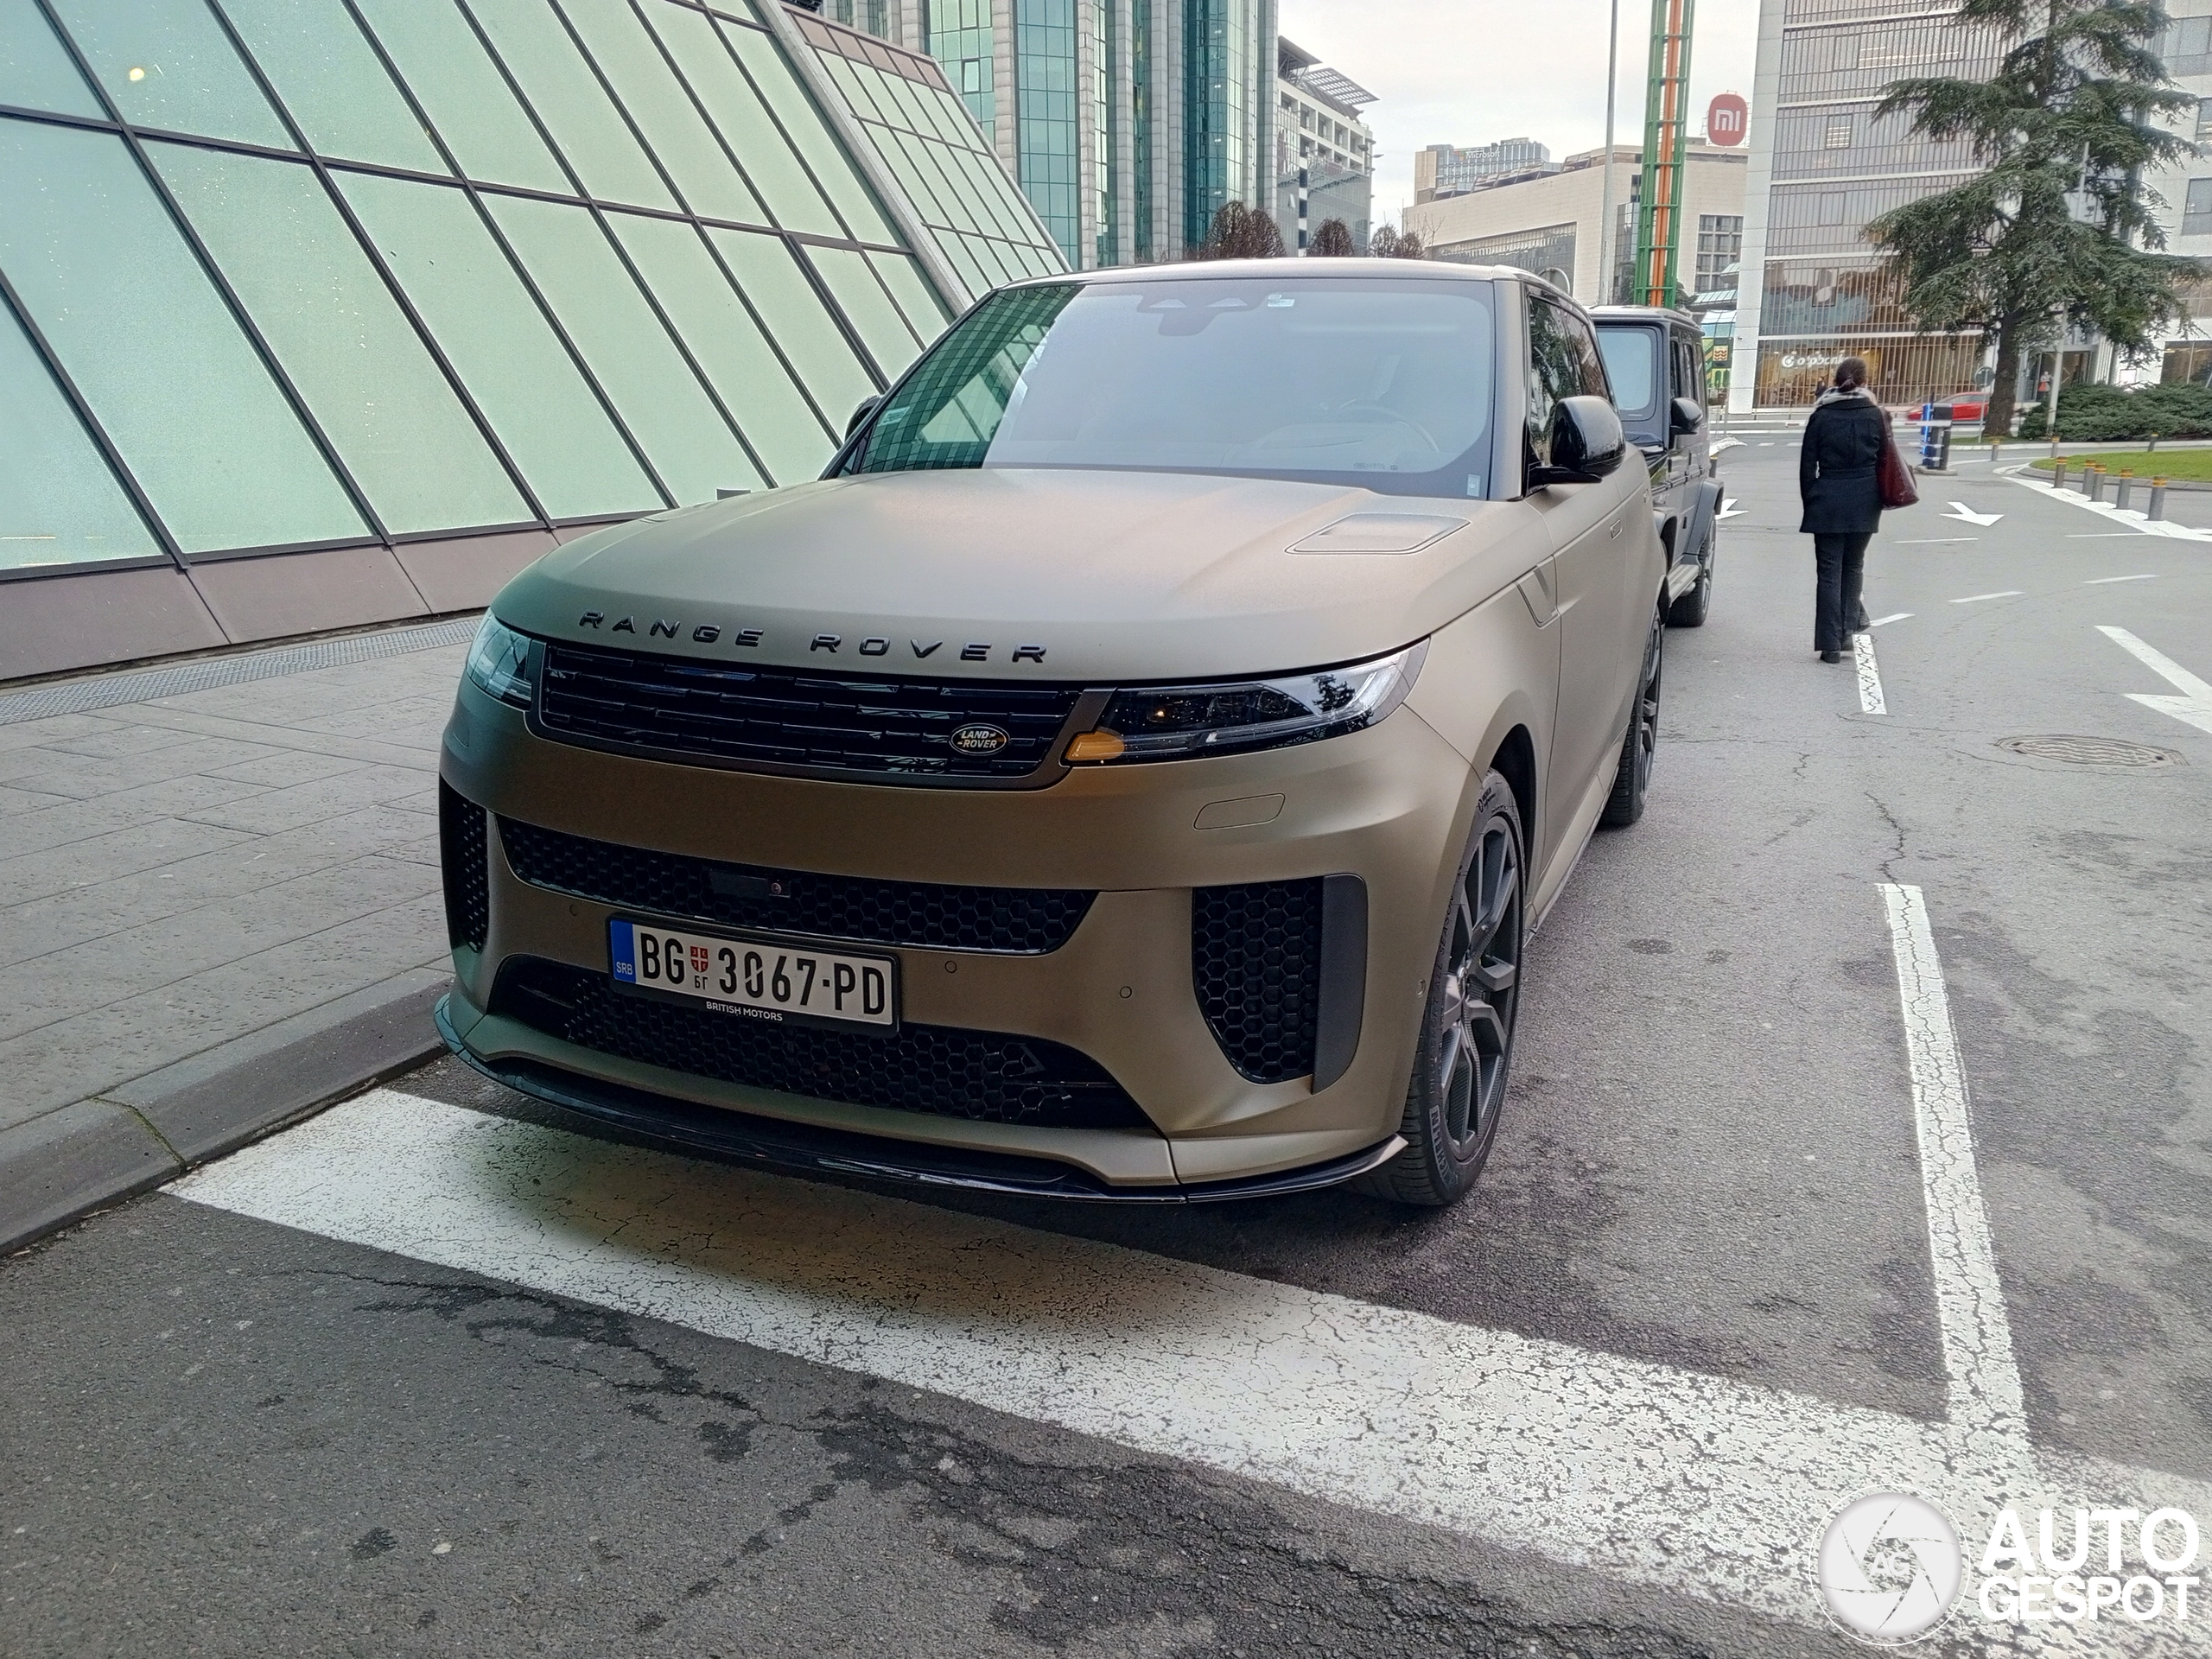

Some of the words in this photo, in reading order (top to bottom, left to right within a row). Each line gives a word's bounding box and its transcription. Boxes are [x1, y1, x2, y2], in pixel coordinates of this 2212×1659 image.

[1465, 149, 1501, 160] Microsoft
[579, 610, 765, 647] RANGE
[810, 632, 1047, 664] ROVER
[961, 730, 990, 739] LAND
[963, 740, 997, 748] ROVER
[640, 932, 685, 984] BG
[616, 961, 632, 976] SRB
[706, 1001, 741, 1015] BRITISH
[743, 1008, 783, 1021] MOTORS
